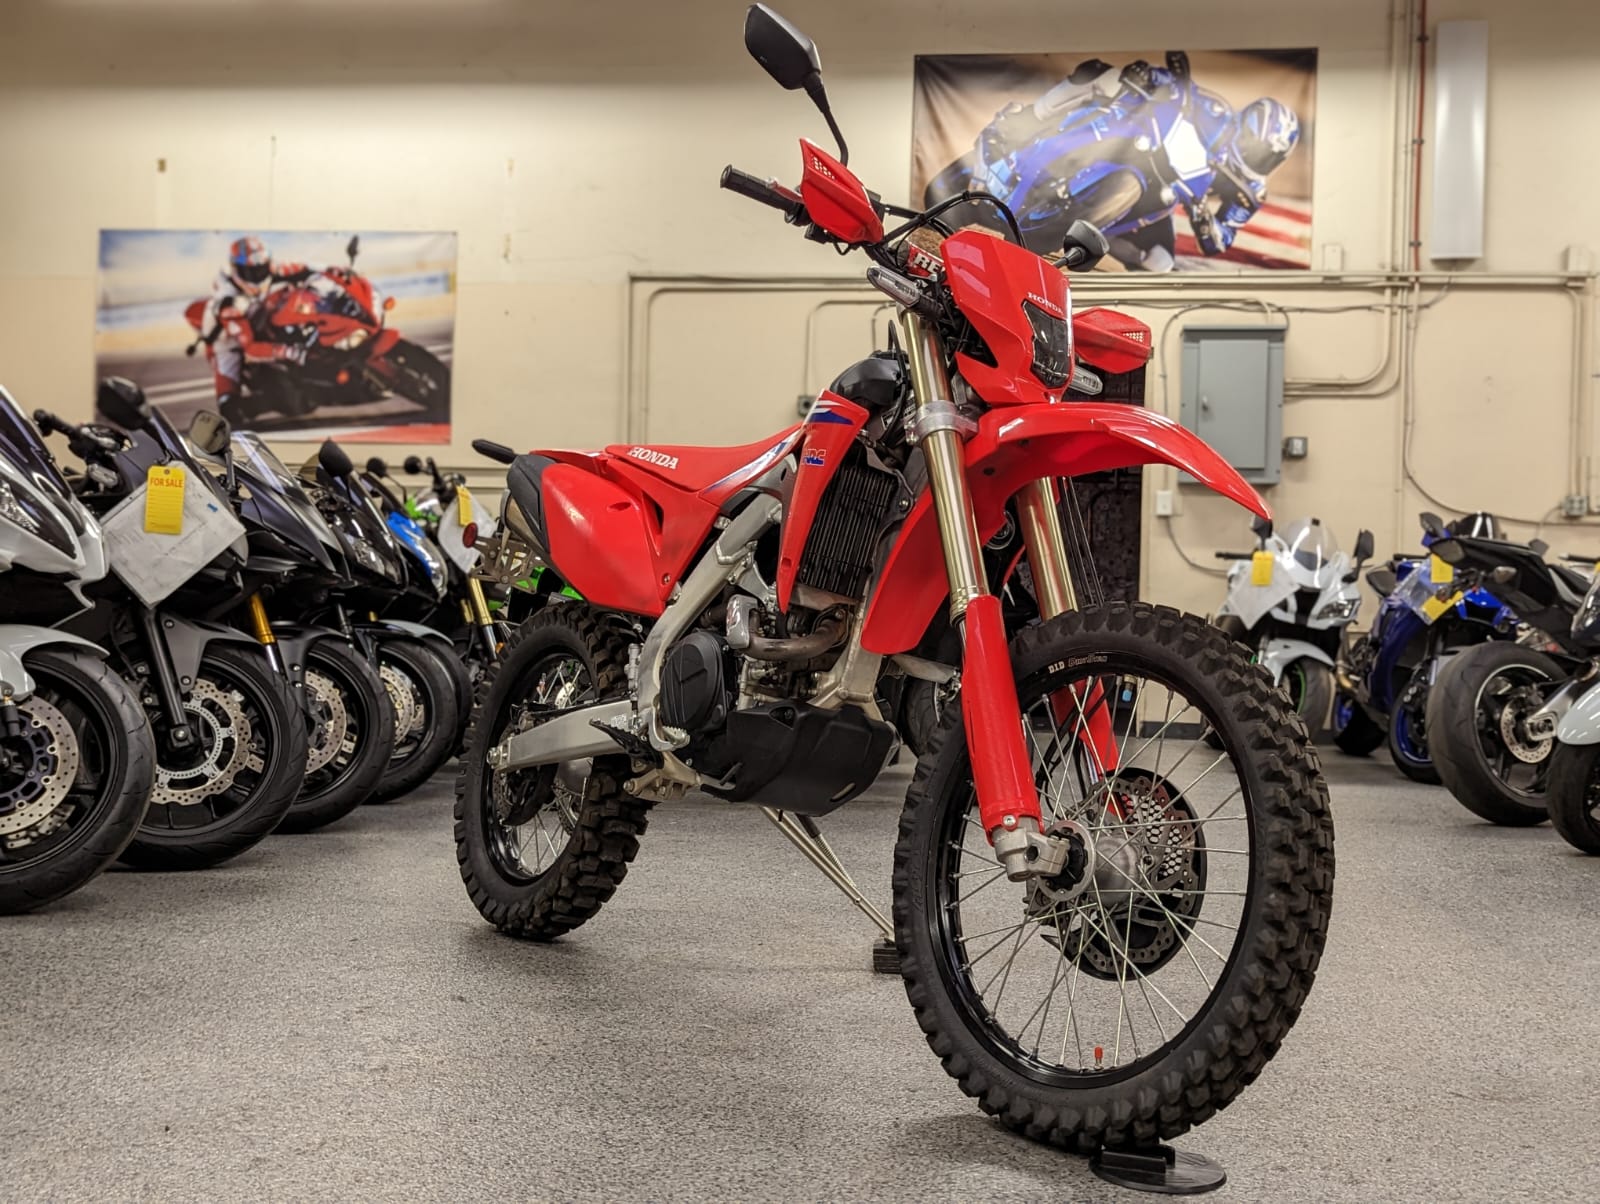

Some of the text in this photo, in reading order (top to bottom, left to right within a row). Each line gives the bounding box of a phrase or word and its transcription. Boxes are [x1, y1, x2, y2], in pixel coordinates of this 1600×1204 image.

[914, 252, 946, 273] RE
[1027, 291, 1064, 316] HONDA
[626, 446, 679, 470] HONDA
[150, 477, 184, 489] FOR SALE
